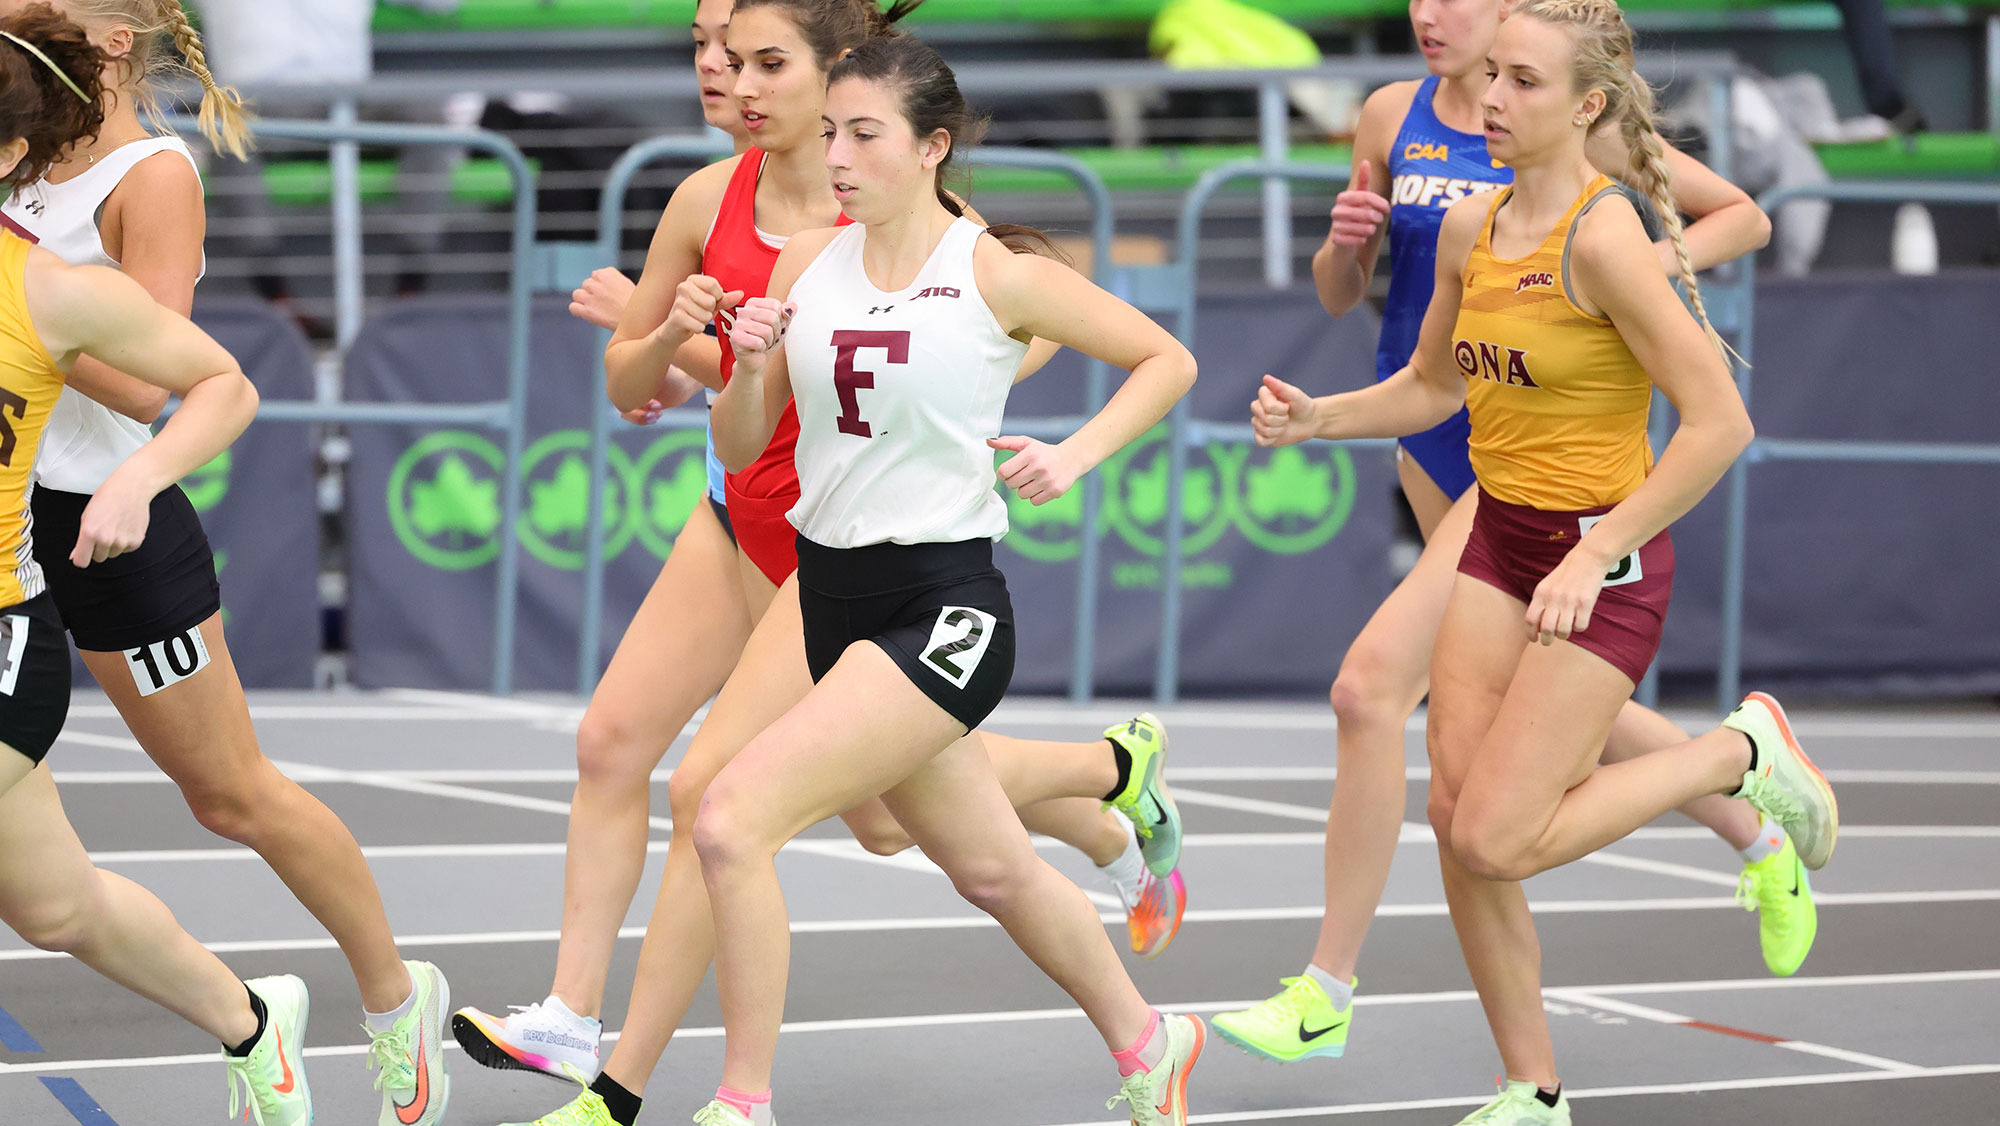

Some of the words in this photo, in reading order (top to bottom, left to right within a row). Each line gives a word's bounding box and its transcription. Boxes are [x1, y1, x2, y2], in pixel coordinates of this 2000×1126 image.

[1404, 143, 1448, 161] CAA
[1391, 174, 1511, 208] OFST
[1514, 273, 1553, 295] MAAC
[830, 330, 911, 438] F
[1453, 338, 1543, 389] ONA
[131, 629, 199, 690] 10
[926, 609, 984, 680] 2
[522, 1028, 547, 1042] new
[546, 1030, 593, 1053] balance
